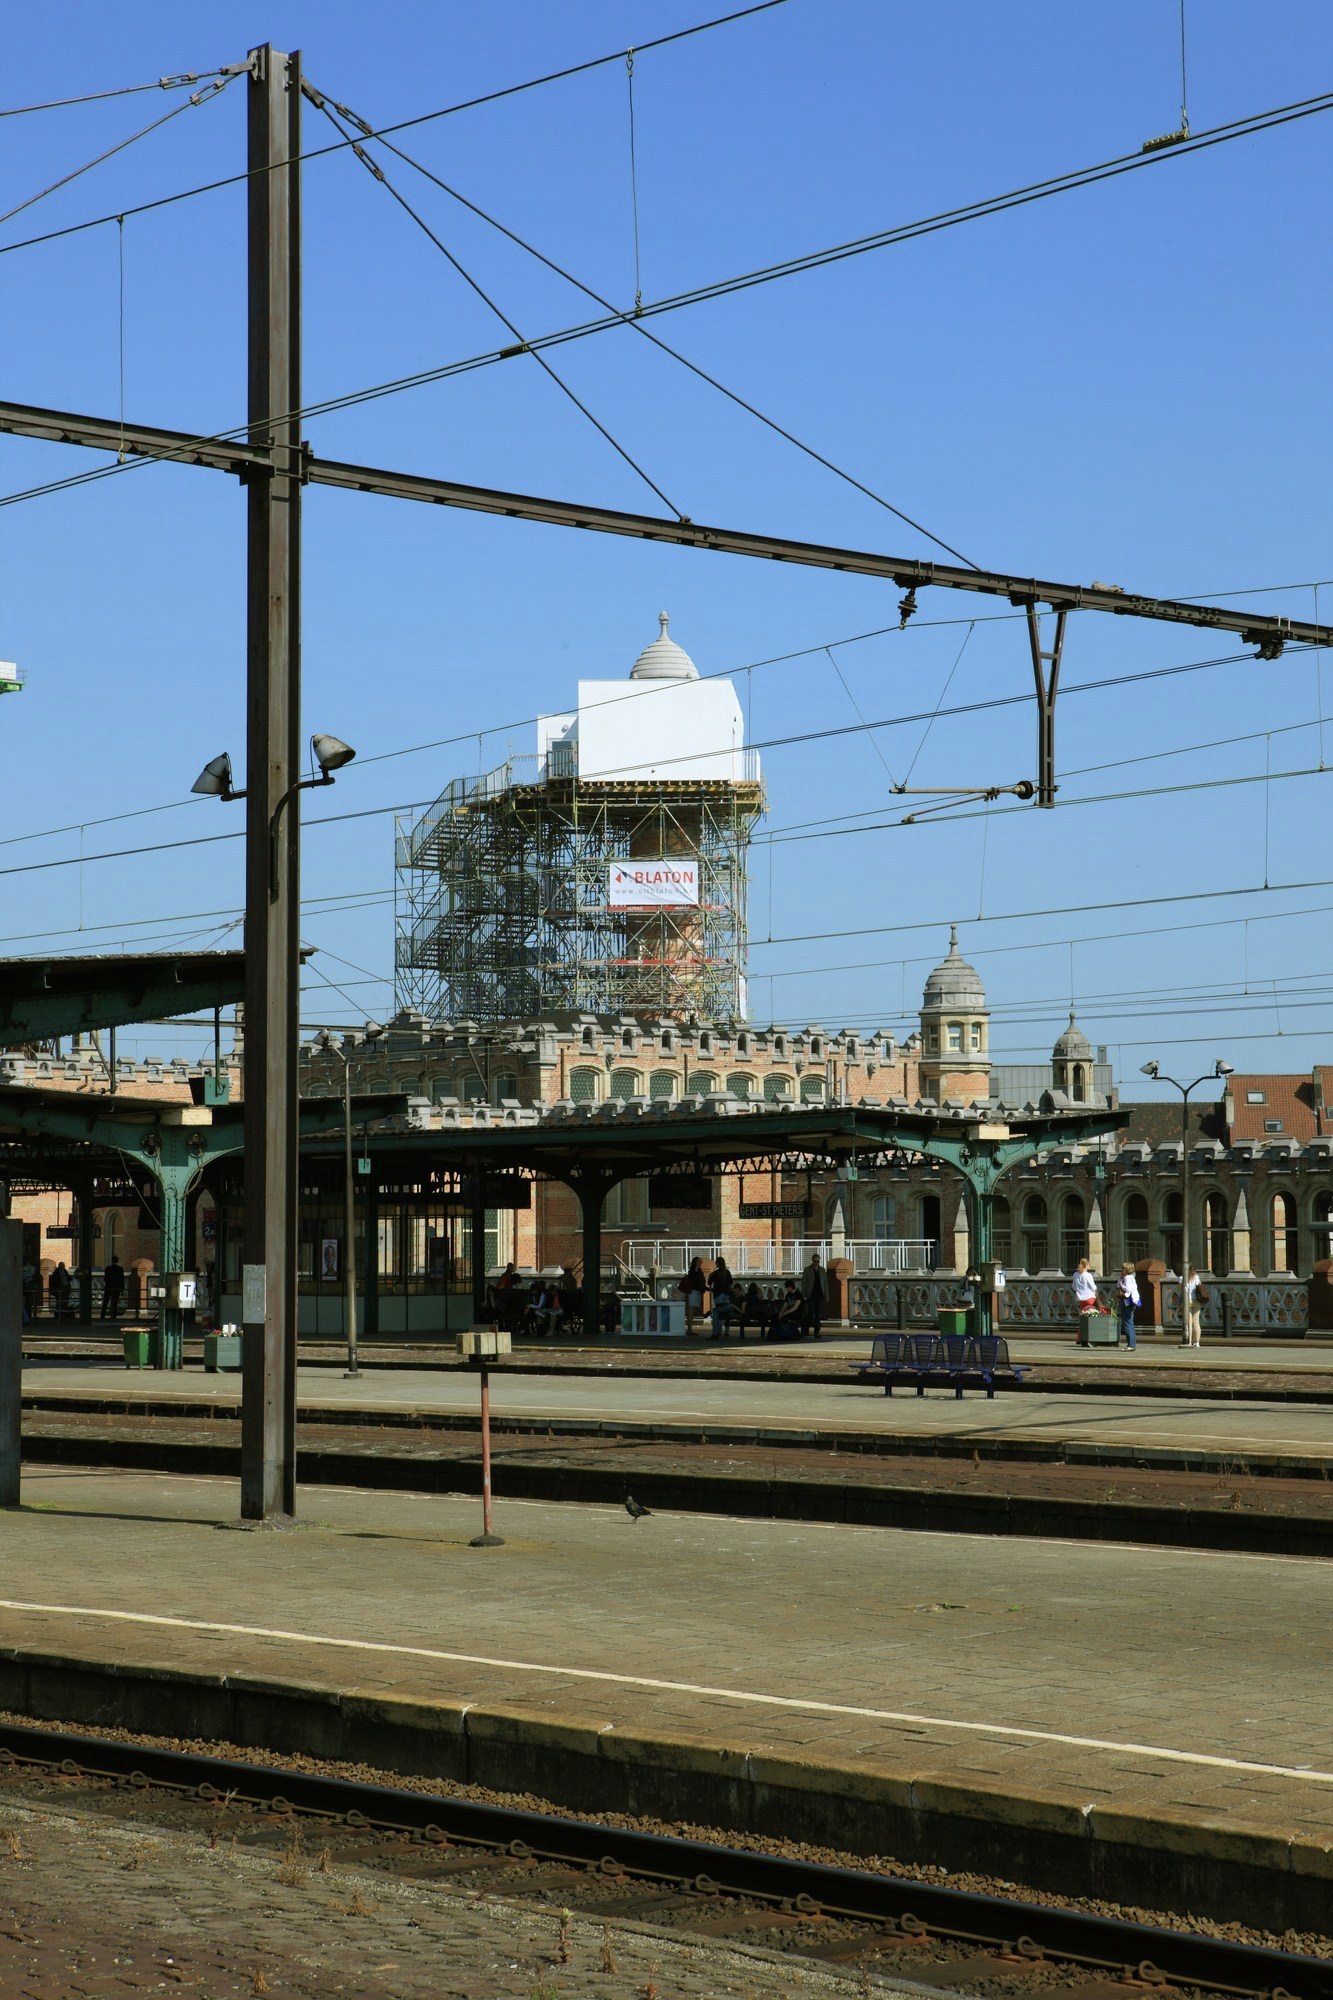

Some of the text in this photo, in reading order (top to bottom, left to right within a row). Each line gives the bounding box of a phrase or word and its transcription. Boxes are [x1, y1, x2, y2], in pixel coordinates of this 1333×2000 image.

[635, 871, 693, 884] BLATON
[998, 1272, 1003, 1284] T
[184, 1284, 191, 1297] T
